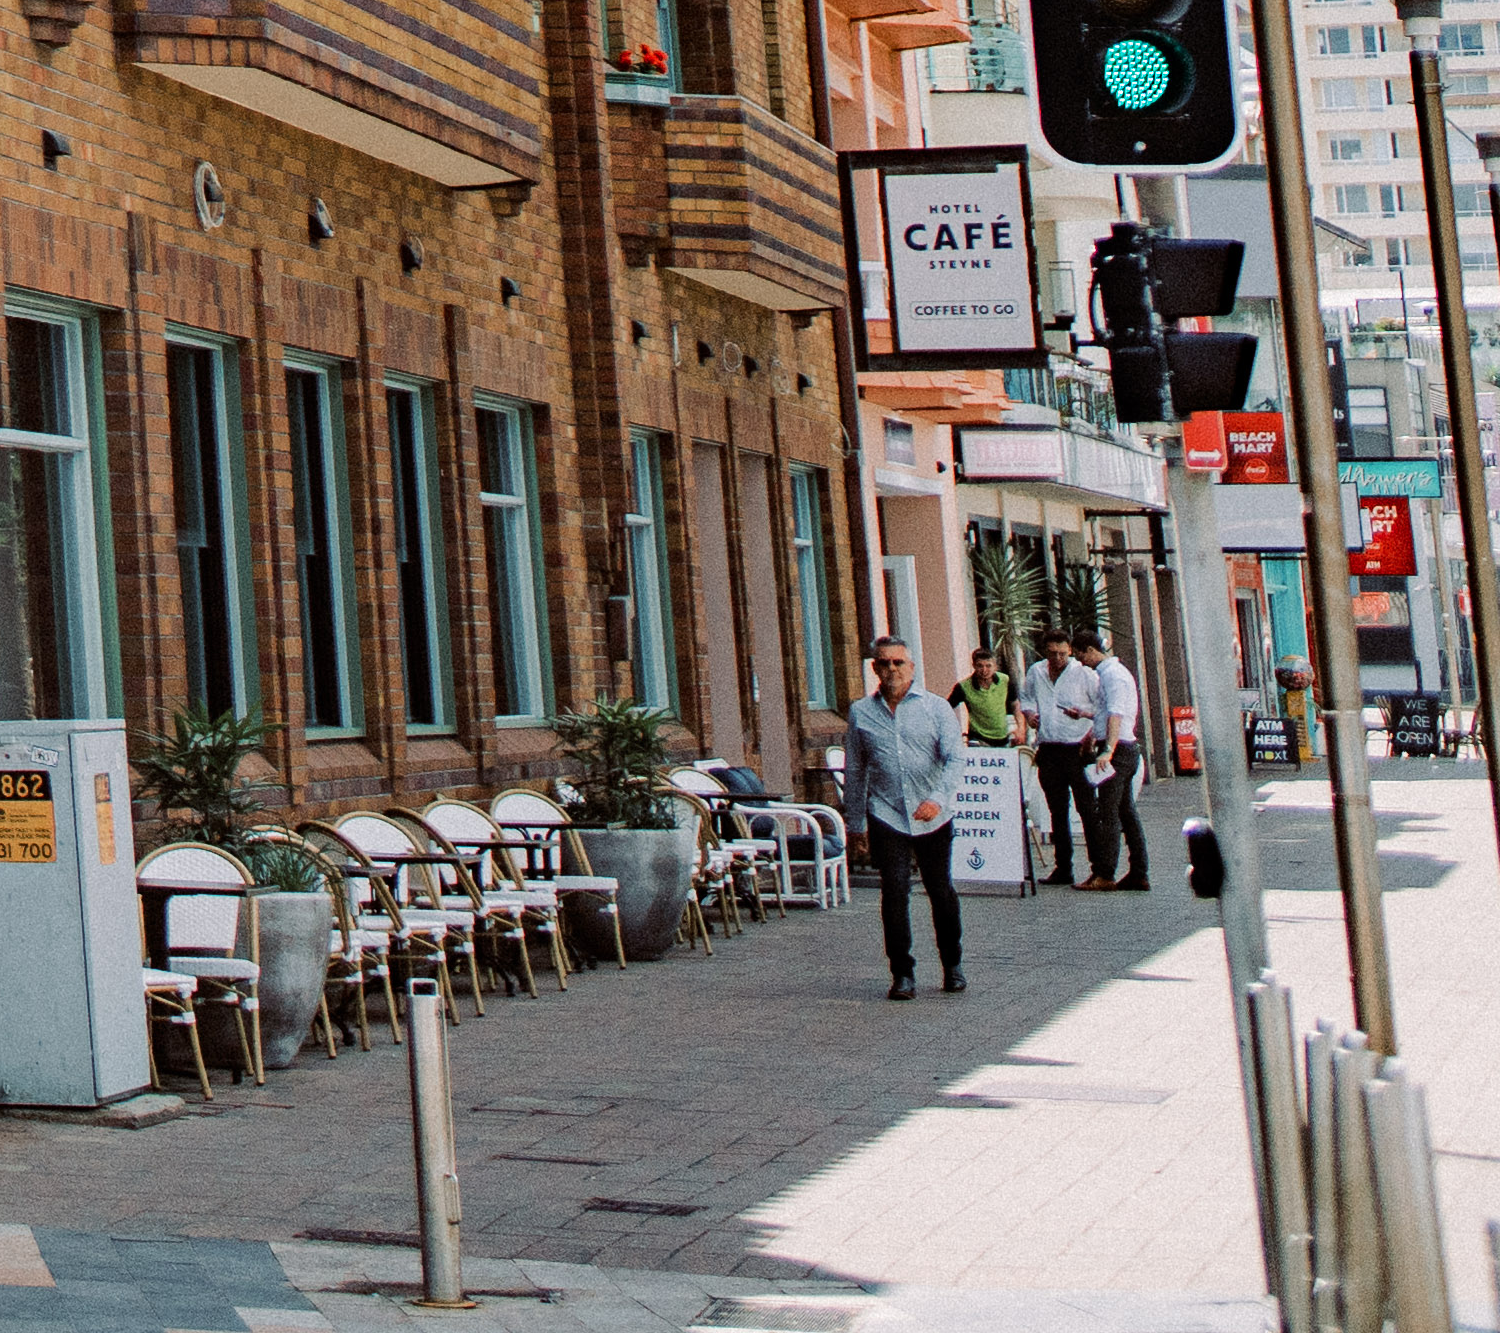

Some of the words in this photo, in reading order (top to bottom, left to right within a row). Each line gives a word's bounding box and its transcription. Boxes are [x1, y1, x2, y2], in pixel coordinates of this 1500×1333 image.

[929, 204, 981, 214] HOTEL
[904, 214, 1013, 251] CAFÉ
[929, 259, 991, 269] STEYNE
[915, 305, 966, 316] COFFEE
[971, 305, 989, 315] TO
[994, 304, 1014, 314] GO
[1229, 432, 1276, 442] BEACH
[1233, 443, 1274, 453] MART
[1403, 698, 1428, 711] WE
[1256, 720, 1284, 731] ATM
[1254, 734, 1288, 746] HERE
[1396, 730, 1434, 745] OPEN
[992, 775, 1002, 785] &
[956, 792, 989, 803] BEER
[953, 828, 996, 838] ENTRY
[19, 843, 53, 858] 700
